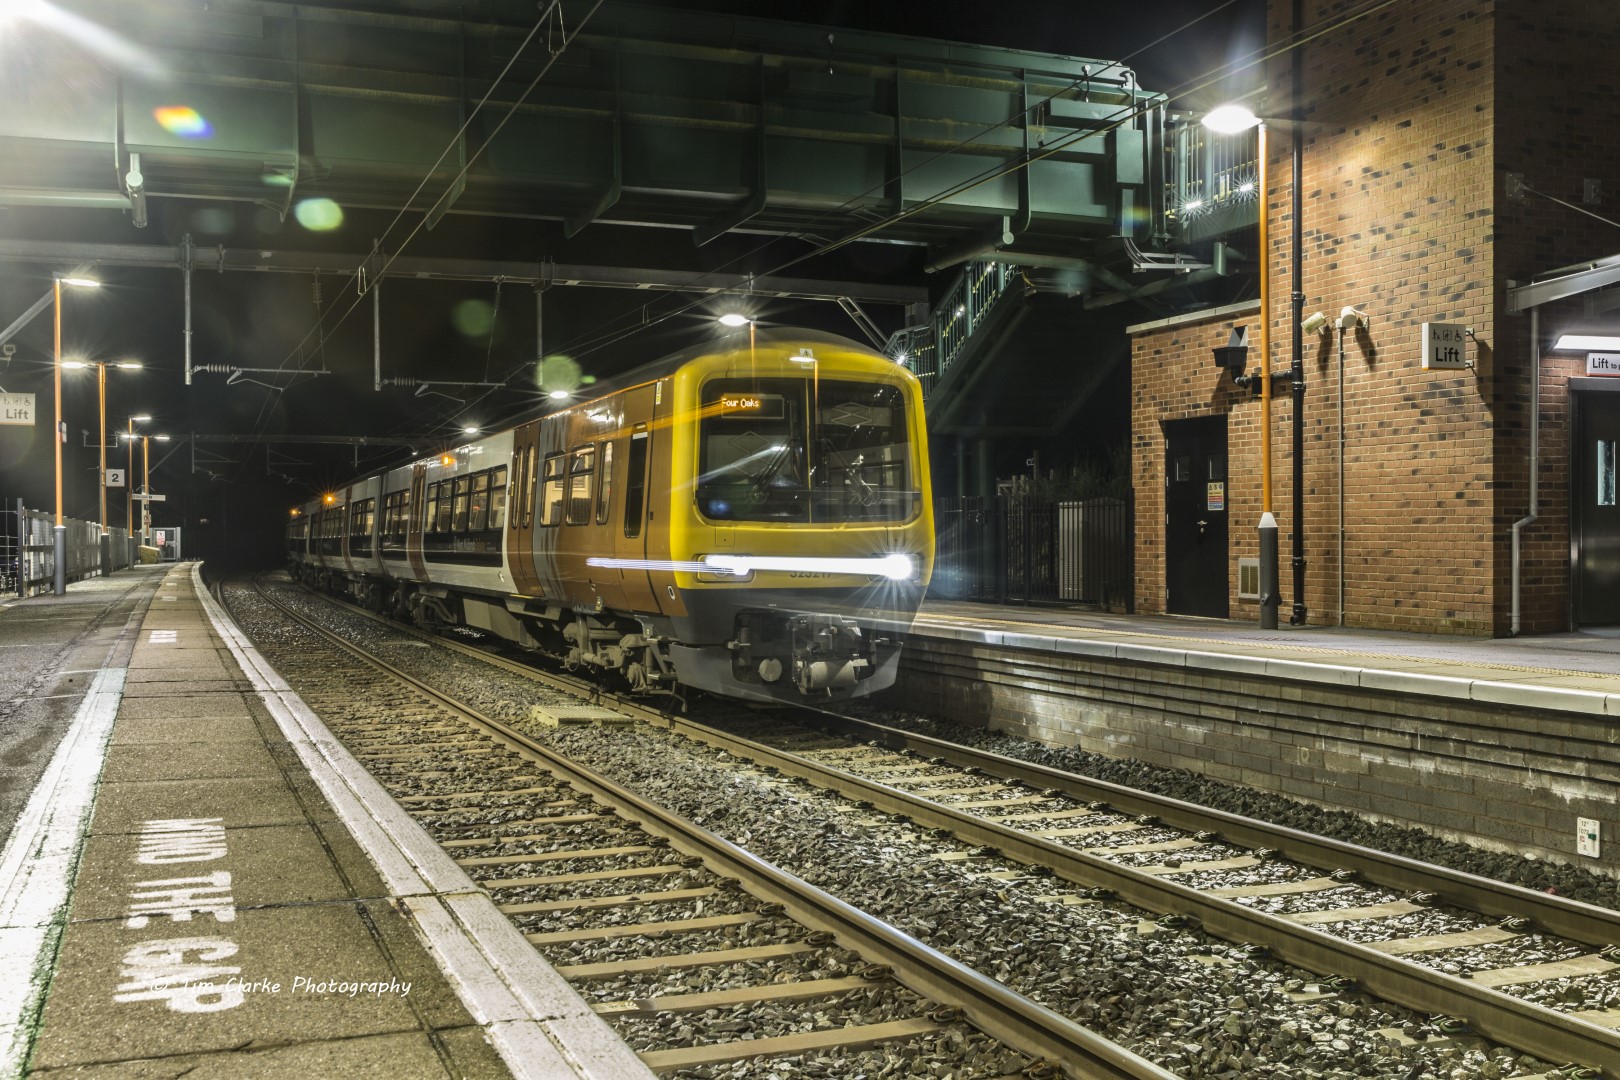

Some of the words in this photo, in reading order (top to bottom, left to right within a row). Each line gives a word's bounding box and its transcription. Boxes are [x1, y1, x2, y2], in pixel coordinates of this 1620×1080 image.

[1435, 347, 1460, 363] Lift
[1592, 357, 1609, 369] Lift
[721, 398, 739, 407] Four
[740, 398, 759, 408] Oaks
[5, 408, 29, 420] Lift
[111, 473, 119, 483] 2
[136, 817, 229, 865] MIND
[126, 870, 237, 930] THE
[113, 936, 246, 1014] GAP
